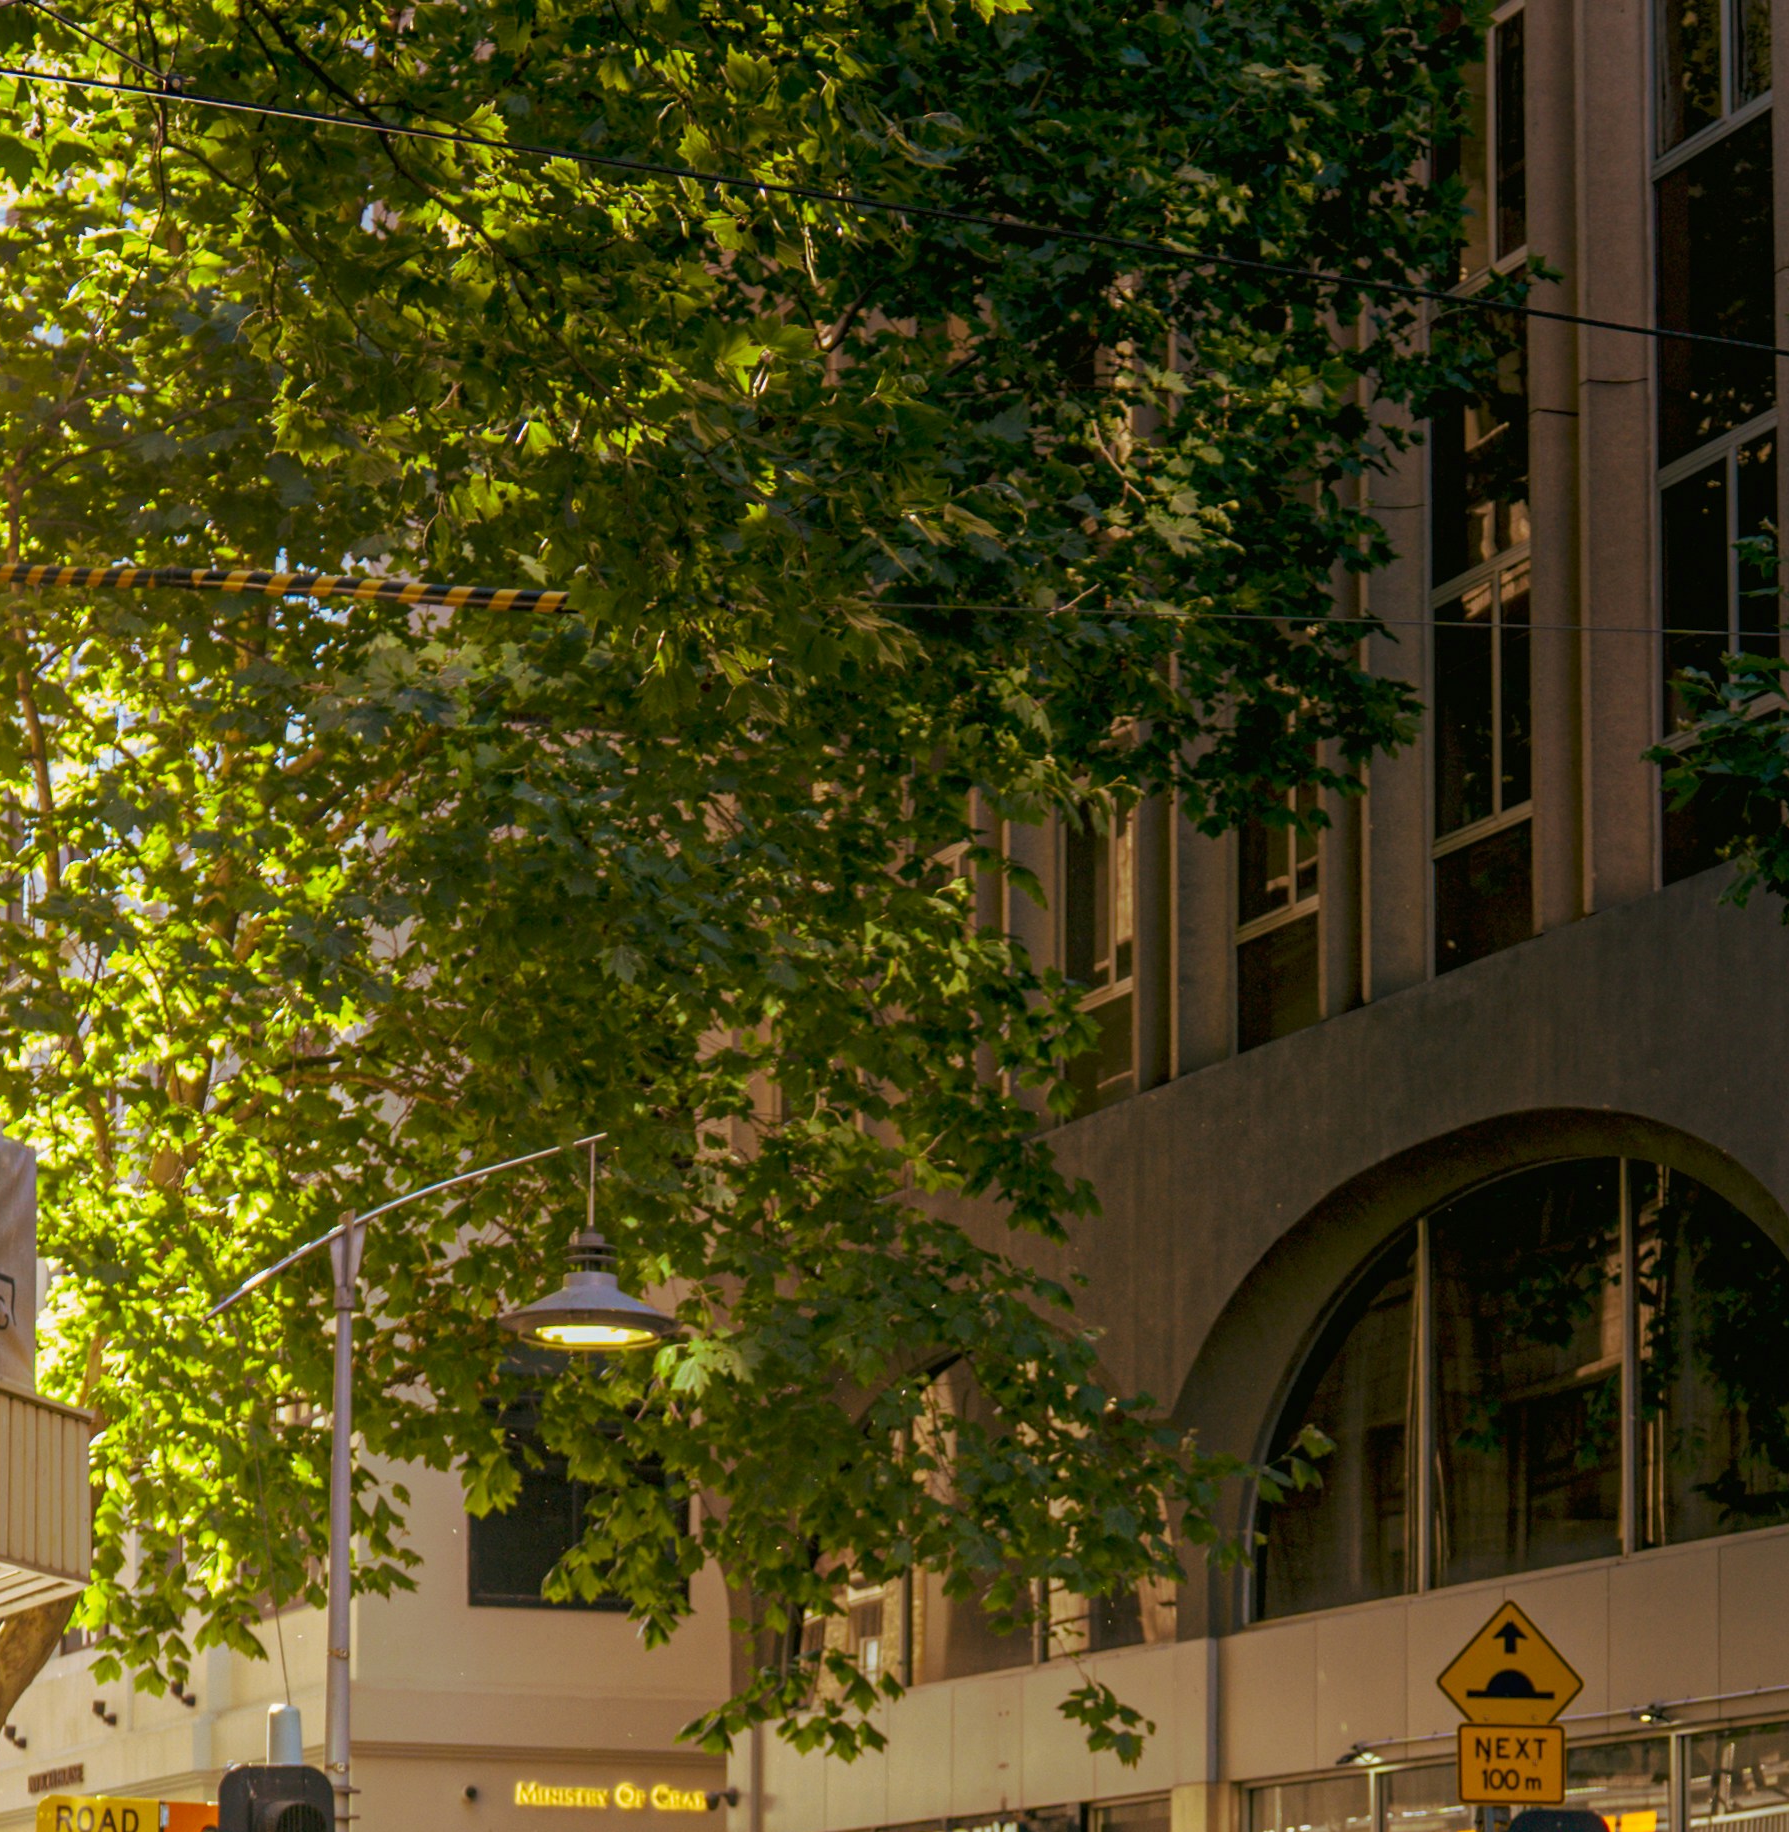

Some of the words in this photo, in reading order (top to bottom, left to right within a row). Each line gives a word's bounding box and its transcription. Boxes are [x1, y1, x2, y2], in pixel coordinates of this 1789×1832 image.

[1475, 1737, 1548, 1761] NEXT
[1482, 1768, 1520, 1791] 100
[1525, 1777, 1542, 1791] m
